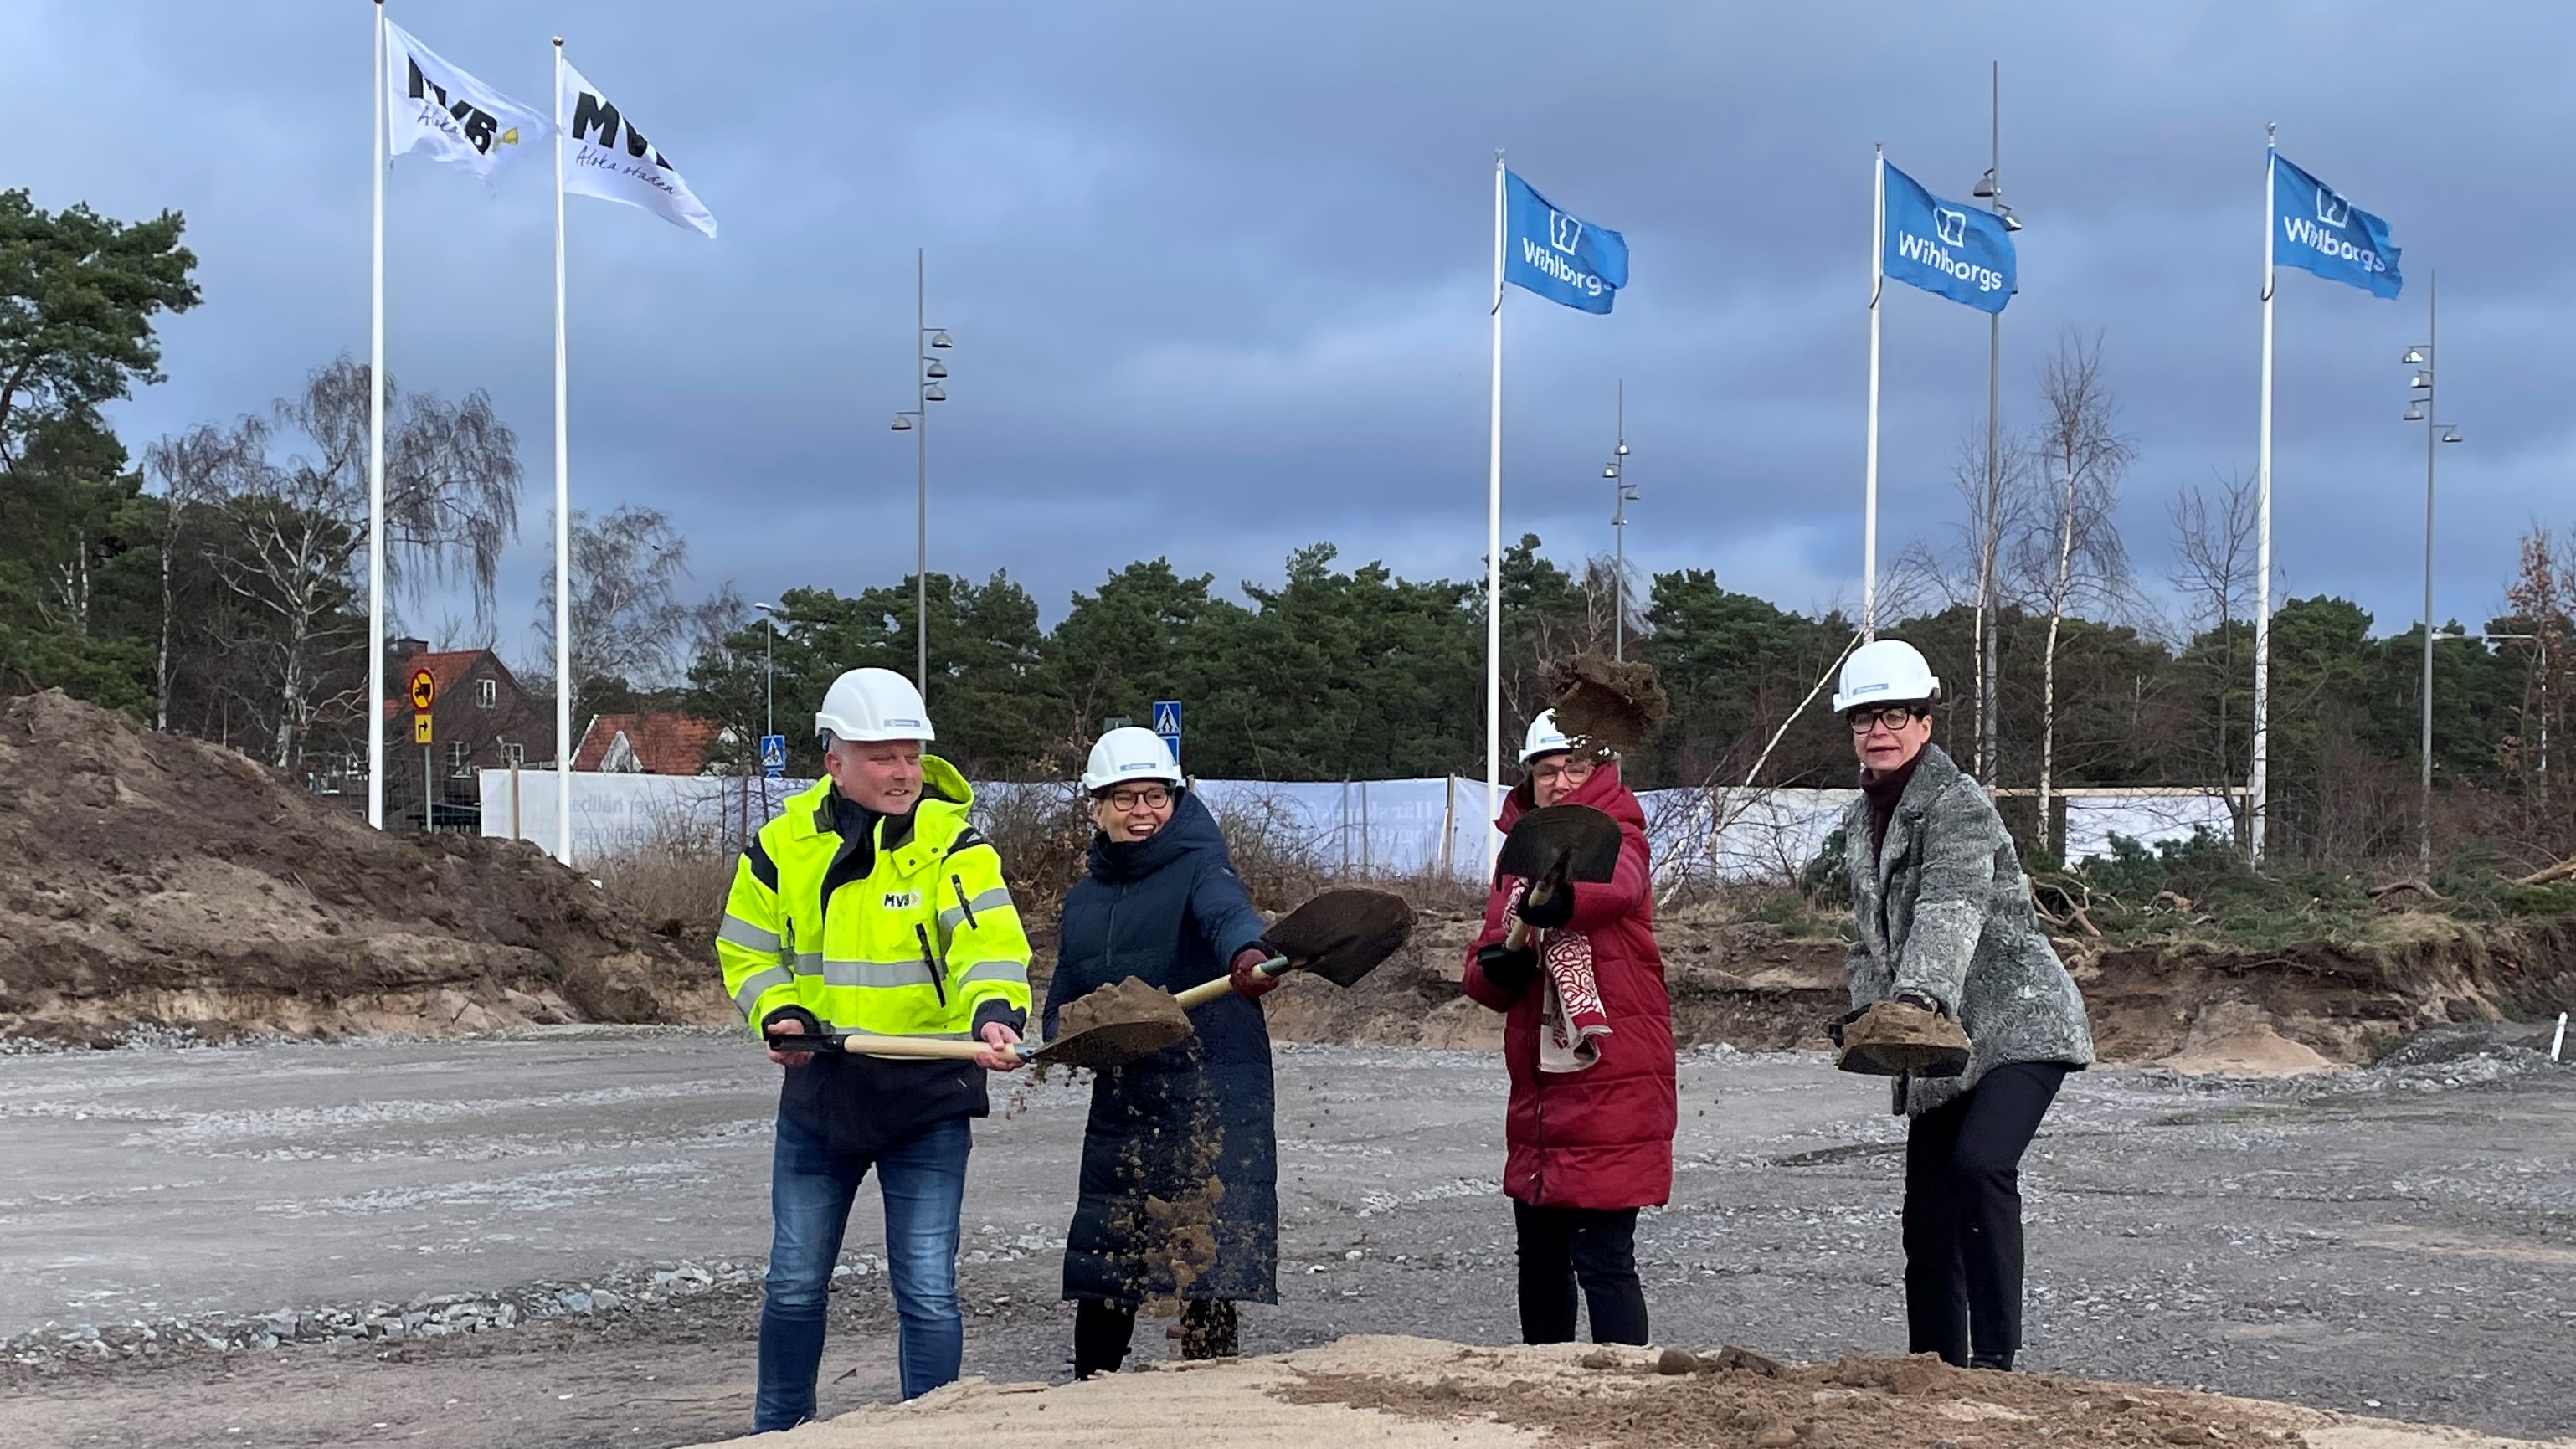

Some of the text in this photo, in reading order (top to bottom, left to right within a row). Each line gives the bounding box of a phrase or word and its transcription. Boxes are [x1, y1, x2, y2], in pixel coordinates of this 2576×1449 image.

[572, 90, 674, 172] MV
[1522, 237, 1612, 296] Wihlbrg
[1899, 229, 2003, 292] Wihlborgs
